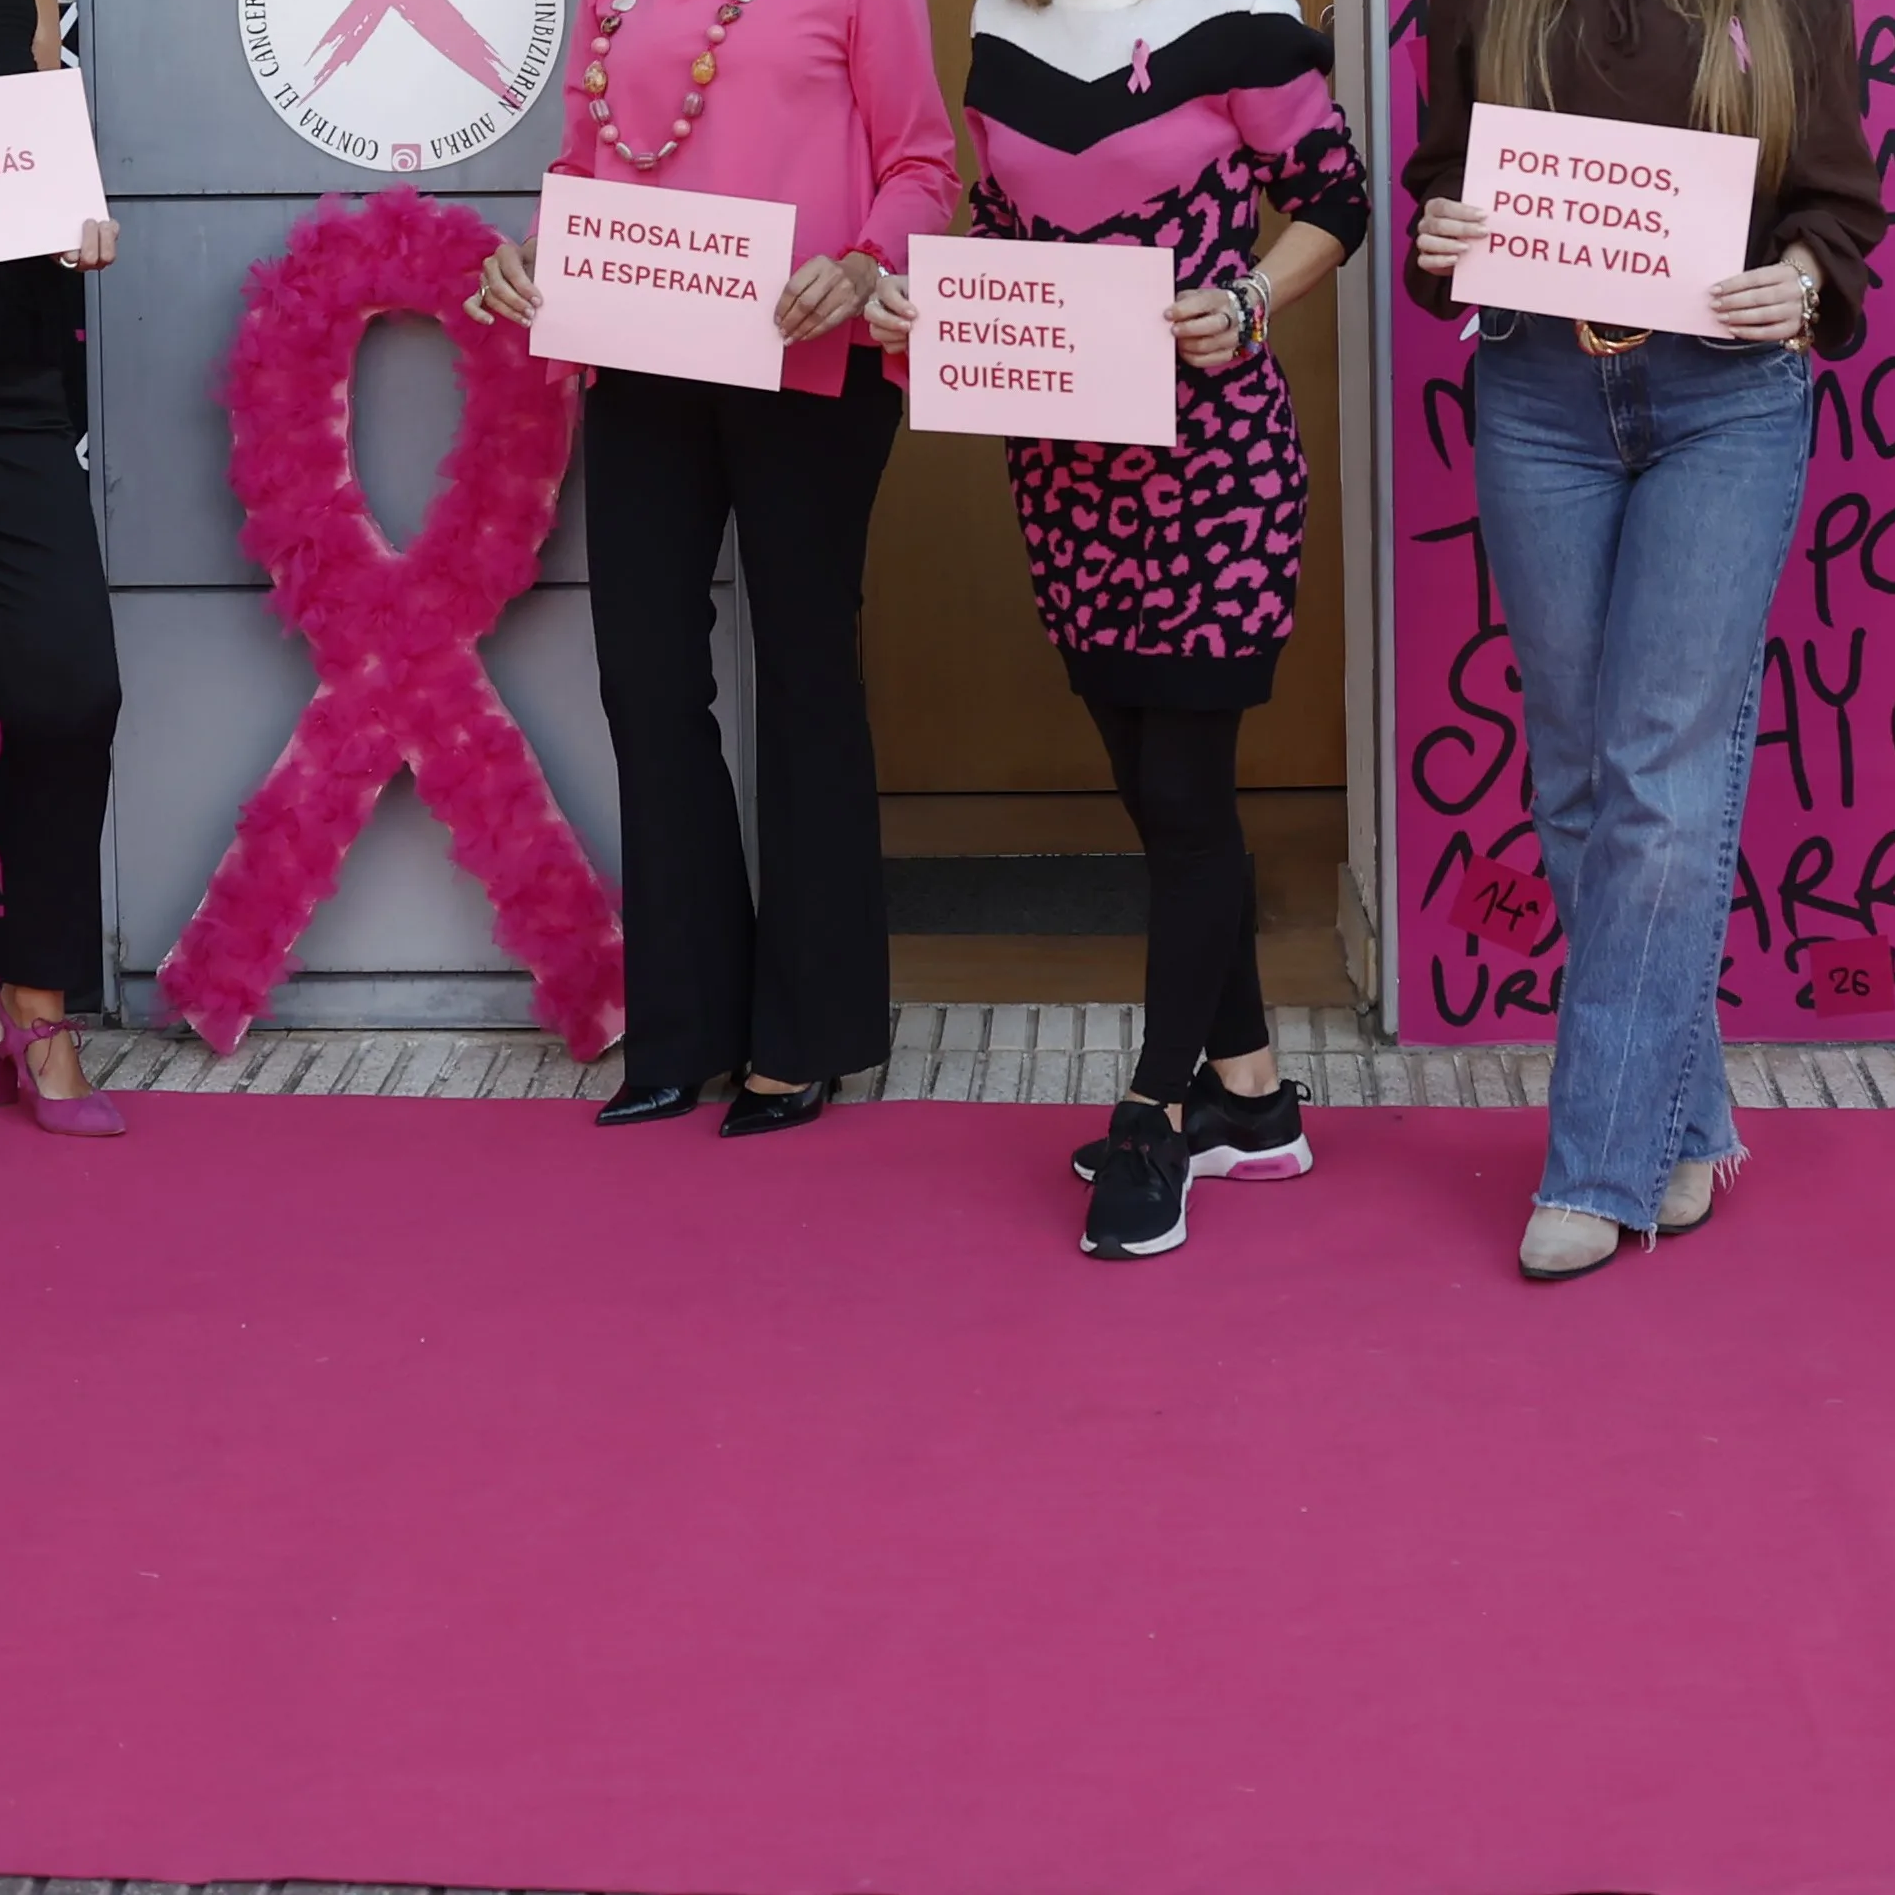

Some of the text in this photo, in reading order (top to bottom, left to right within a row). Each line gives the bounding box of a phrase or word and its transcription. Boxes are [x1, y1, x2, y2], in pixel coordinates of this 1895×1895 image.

[273, 83, 300, 111] EL
[298, 108, 379, 161] CONTRA
[430, 112, 496, 159] AURKA
[1499, 149, 1679, 196] POR TODOS,
[568, 215, 750, 258] EN ROSA LATE
[1494, 191, 1669, 238] POR TODAS,
[1489, 233, 1670, 278] POR LA VIDA
[564, 256, 757, 301] LA ESPERANZA
[938, 273, 1063, 307] CUÍDATE,
[939, 318, 1074, 352] REVÍSATE,
[940, 362, 1073, 393] QUIÉRETE
[1827, 966, 1872, 998] 26
